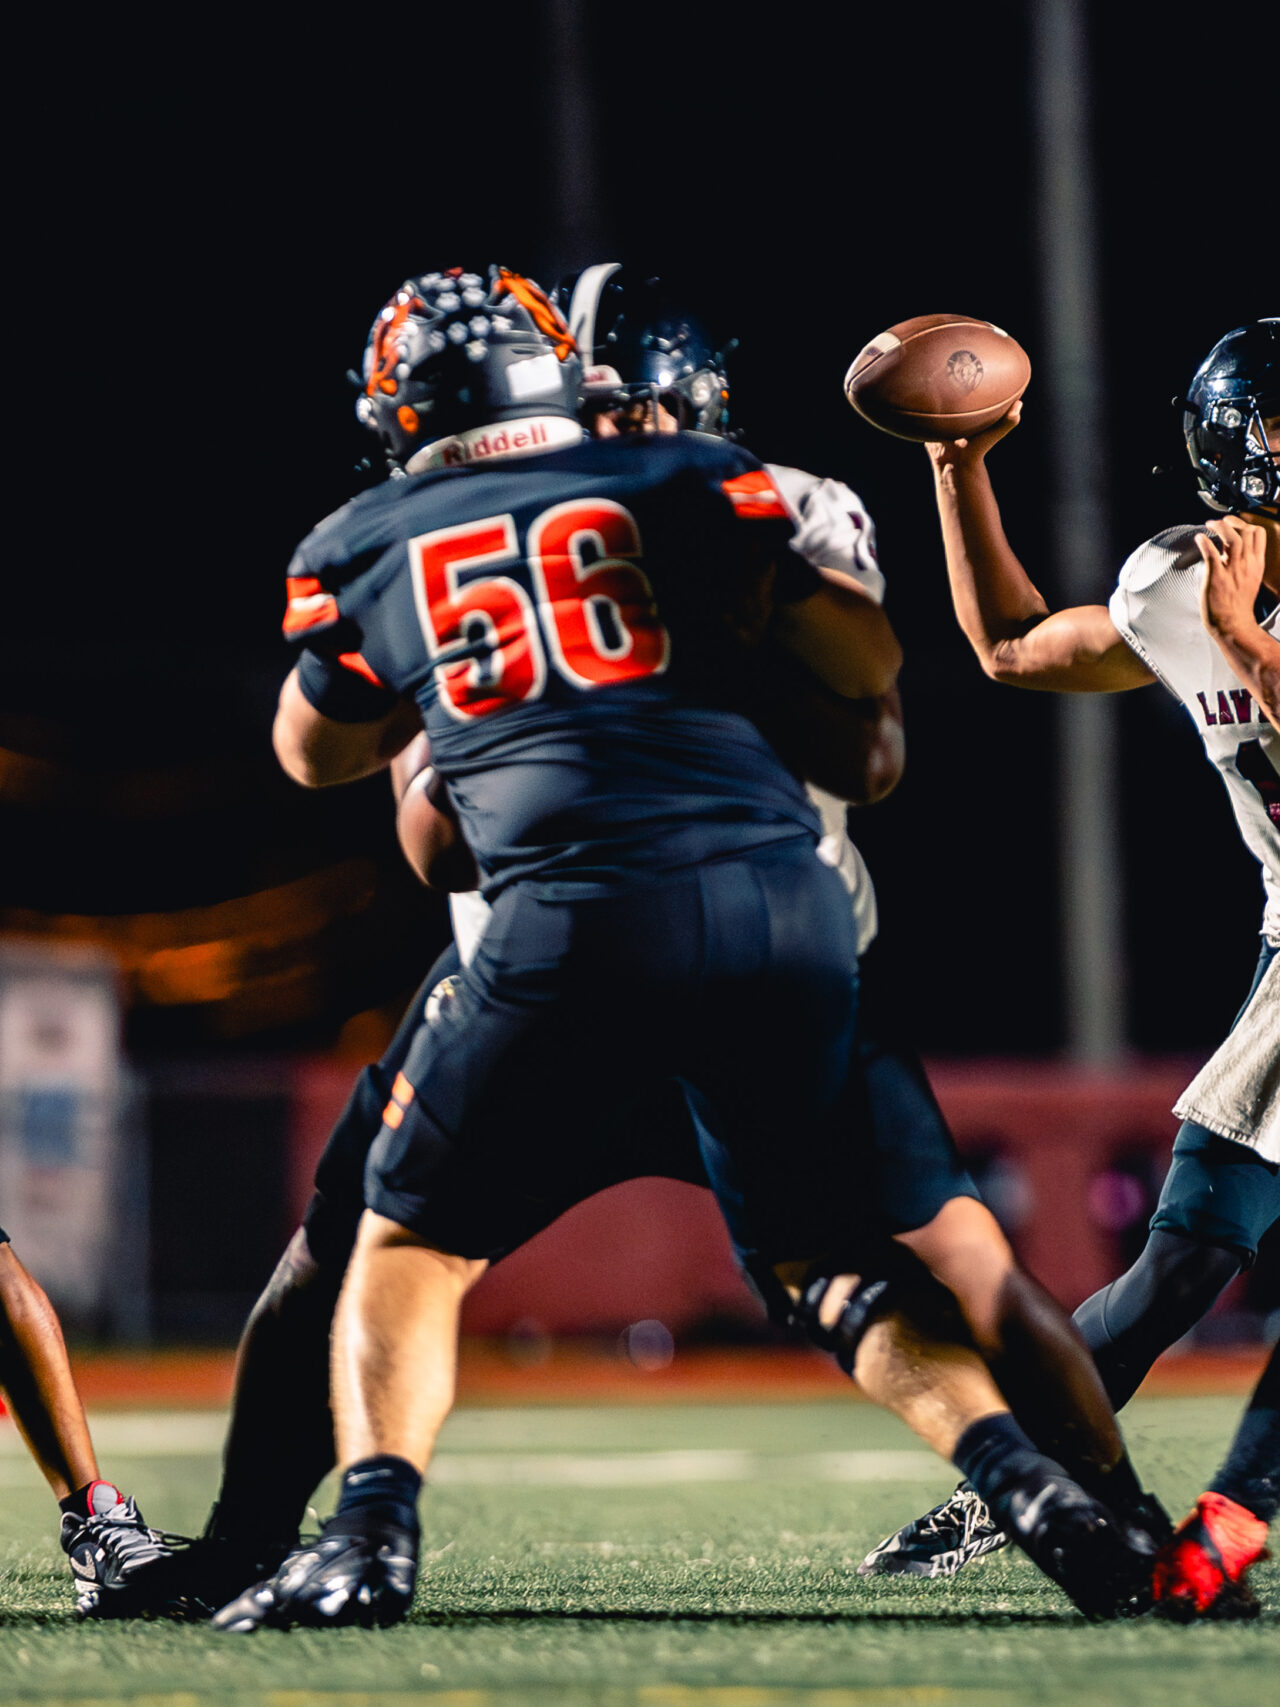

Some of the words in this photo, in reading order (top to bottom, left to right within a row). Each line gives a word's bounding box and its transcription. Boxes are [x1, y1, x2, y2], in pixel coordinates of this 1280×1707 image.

[443, 423, 548, 466] Riddell
[408, 497, 671, 721] 56
[1196, 688, 1271, 726] LAW
